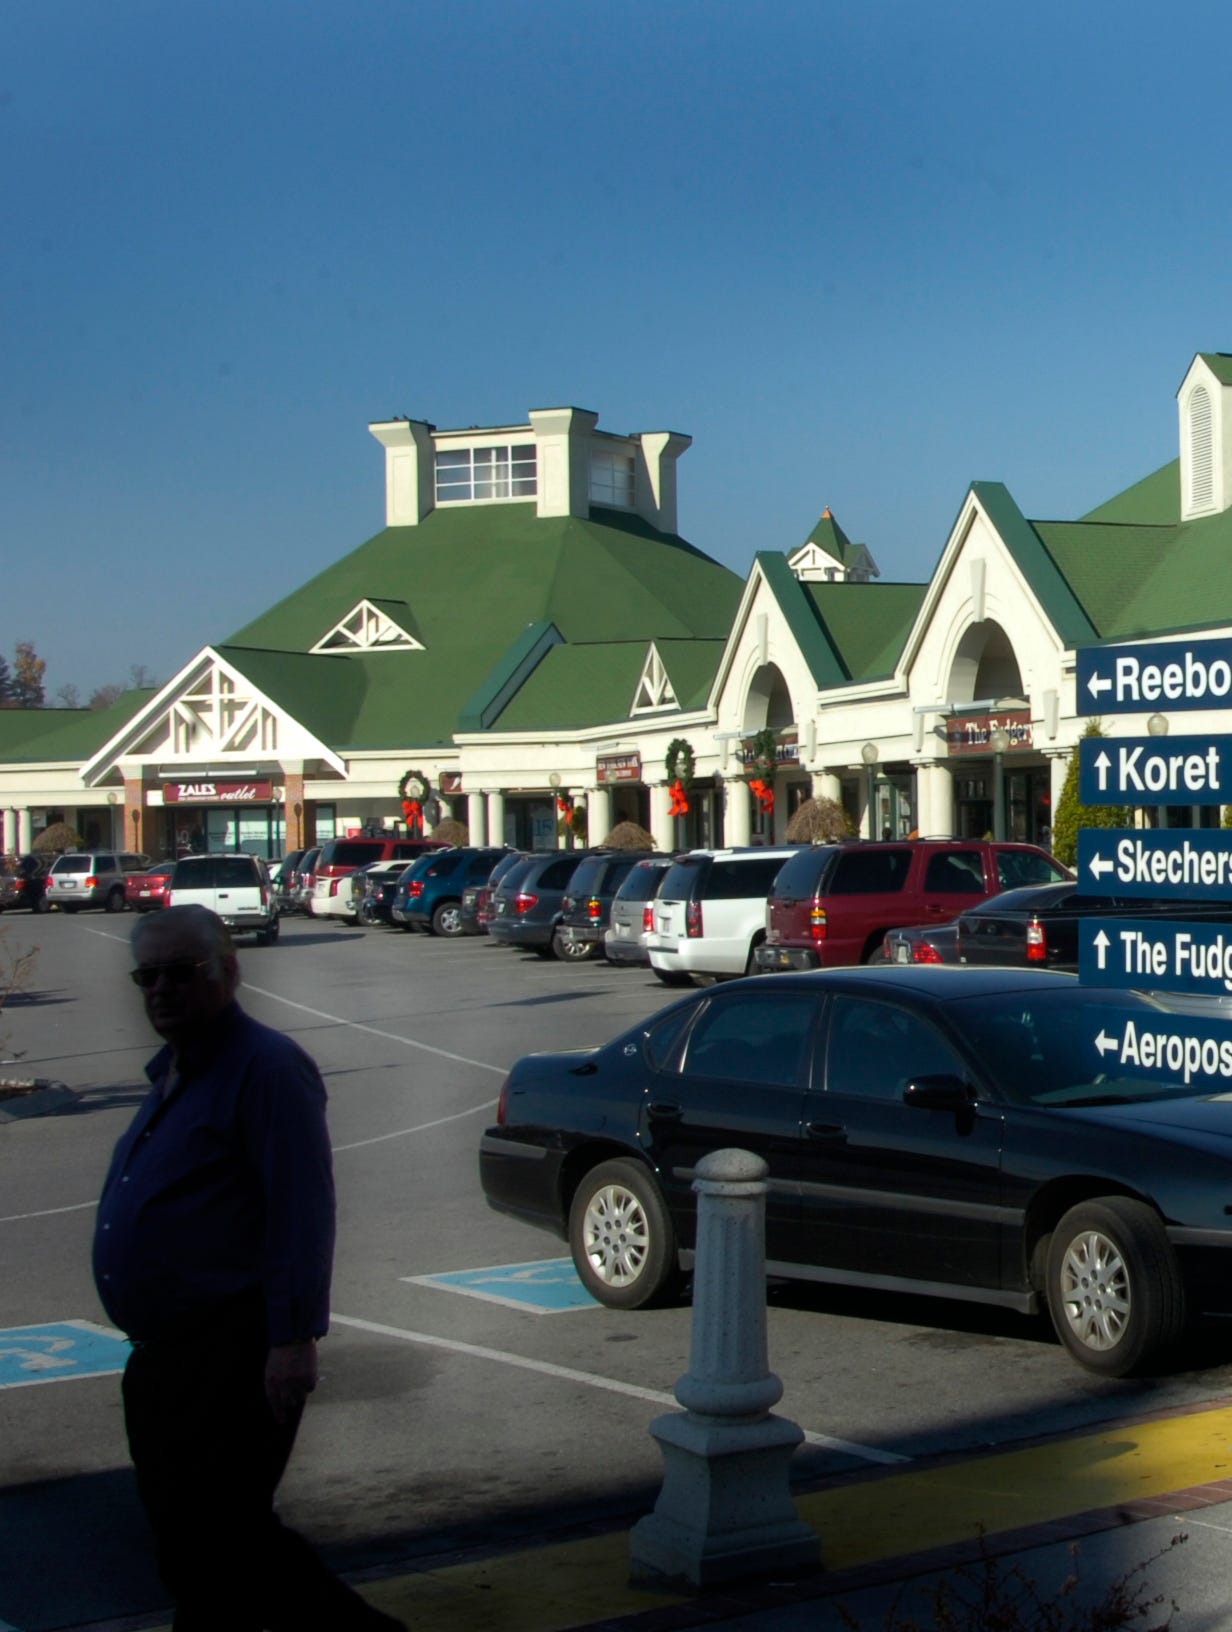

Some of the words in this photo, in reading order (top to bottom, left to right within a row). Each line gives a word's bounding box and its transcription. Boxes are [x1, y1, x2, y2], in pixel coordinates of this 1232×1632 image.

[965, 721, 987, 745] The
[1119, 746, 1220, 792] Koret
[178, 783, 217, 796] ZALES
[1120, 931, 1168, 976] The
